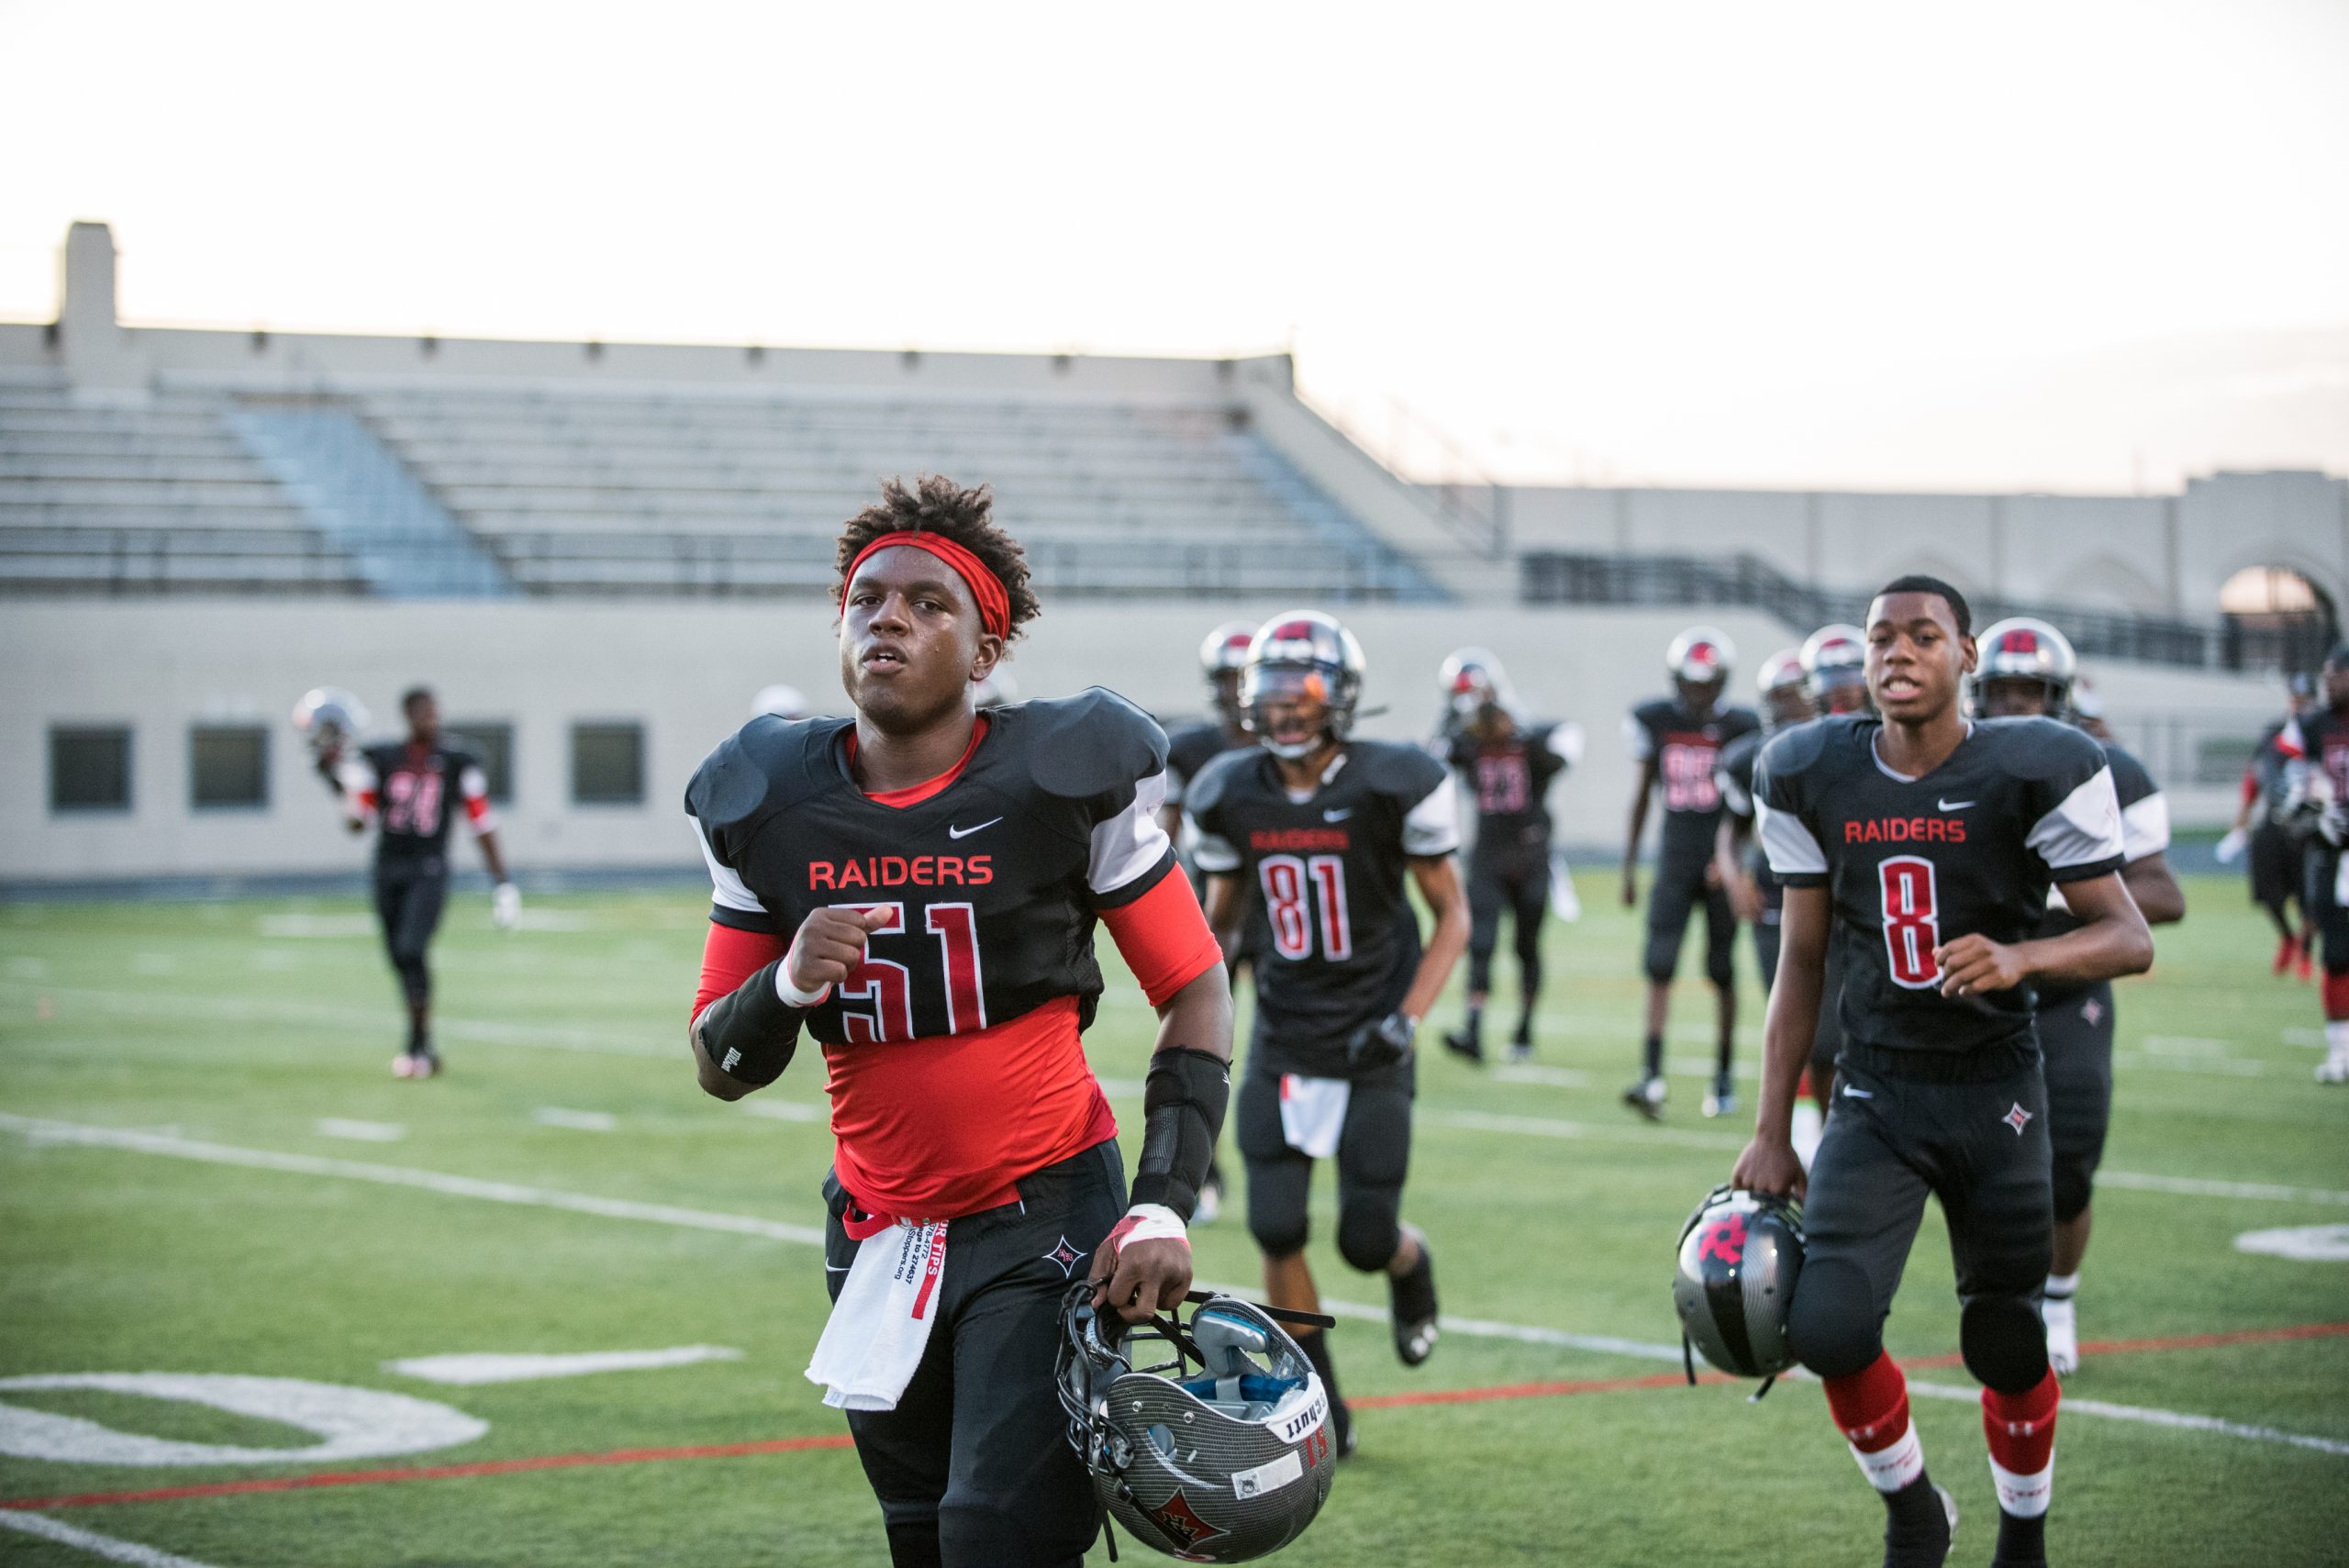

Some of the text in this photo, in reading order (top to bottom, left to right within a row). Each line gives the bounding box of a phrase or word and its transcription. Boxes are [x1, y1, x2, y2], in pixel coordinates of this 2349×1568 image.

[1844, 817, 1967, 844] RAIDERS
[808, 854, 994, 891] RAIDERS
[1257, 853, 1353, 962] 81
[1878, 854, 1944, 990] 8
[914, 1244, 921, 1252] to
[928, 1241, 944, 1275] TIPS
[905, 1254, 919, 1284] 274637
